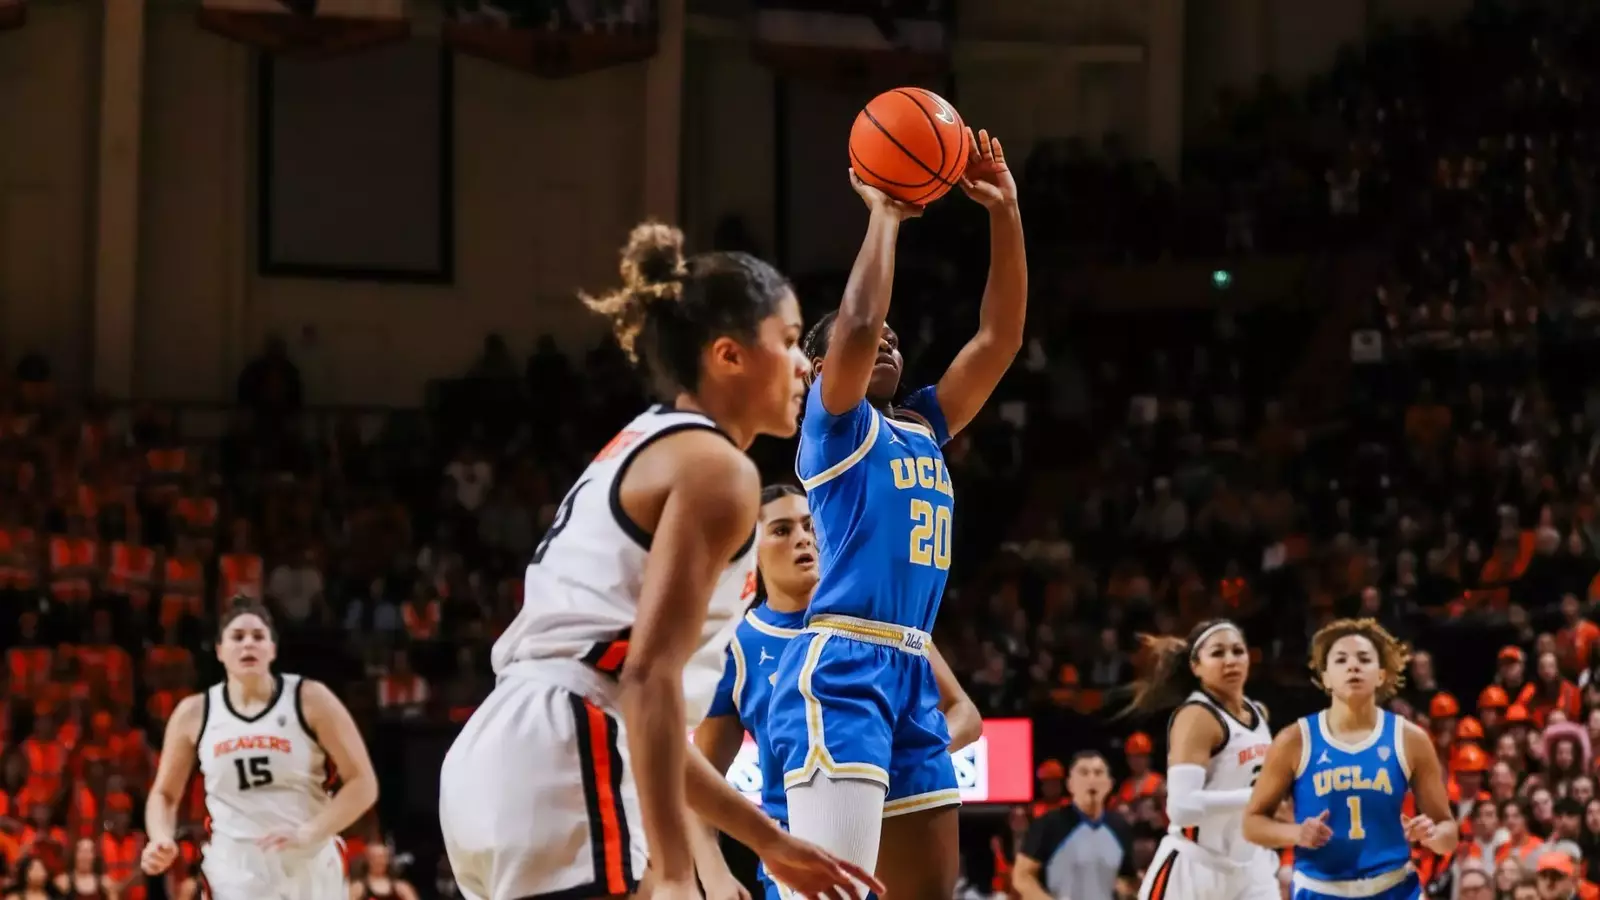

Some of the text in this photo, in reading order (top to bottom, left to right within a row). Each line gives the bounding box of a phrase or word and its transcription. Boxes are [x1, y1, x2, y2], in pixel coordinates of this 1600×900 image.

[890, 457, 954, 498] UCL
[909, 498, 952, 570] 20
[905, 632, 923, 650] Ucla
[213, 736, 291, 757] BEAVERS
[234, 756, 273, 790] 15
[1313, 765, 1392, 797] UCLA
[1347, 796, 1365, 840] 1
